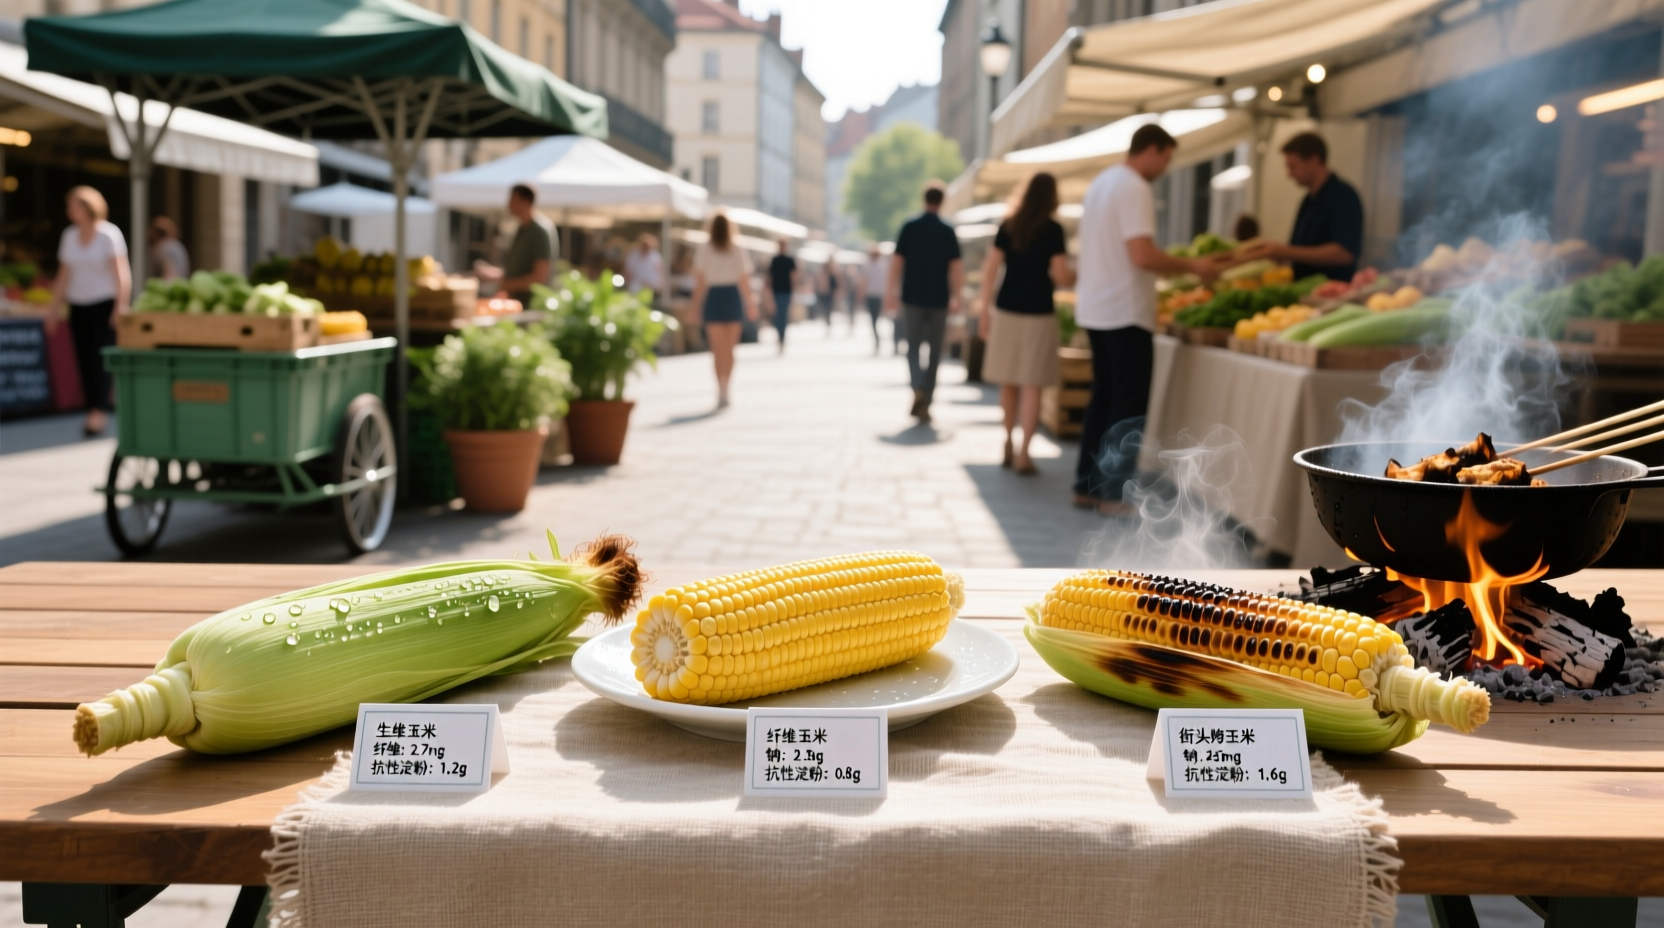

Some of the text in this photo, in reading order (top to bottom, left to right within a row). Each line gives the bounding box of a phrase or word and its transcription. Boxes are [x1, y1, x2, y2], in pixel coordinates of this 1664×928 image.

[766, 727, 828, 745] 纤维玉米
[440, 762, 468, 778] 1.2g
[1258, 767, 1287, 784] 1.6g
